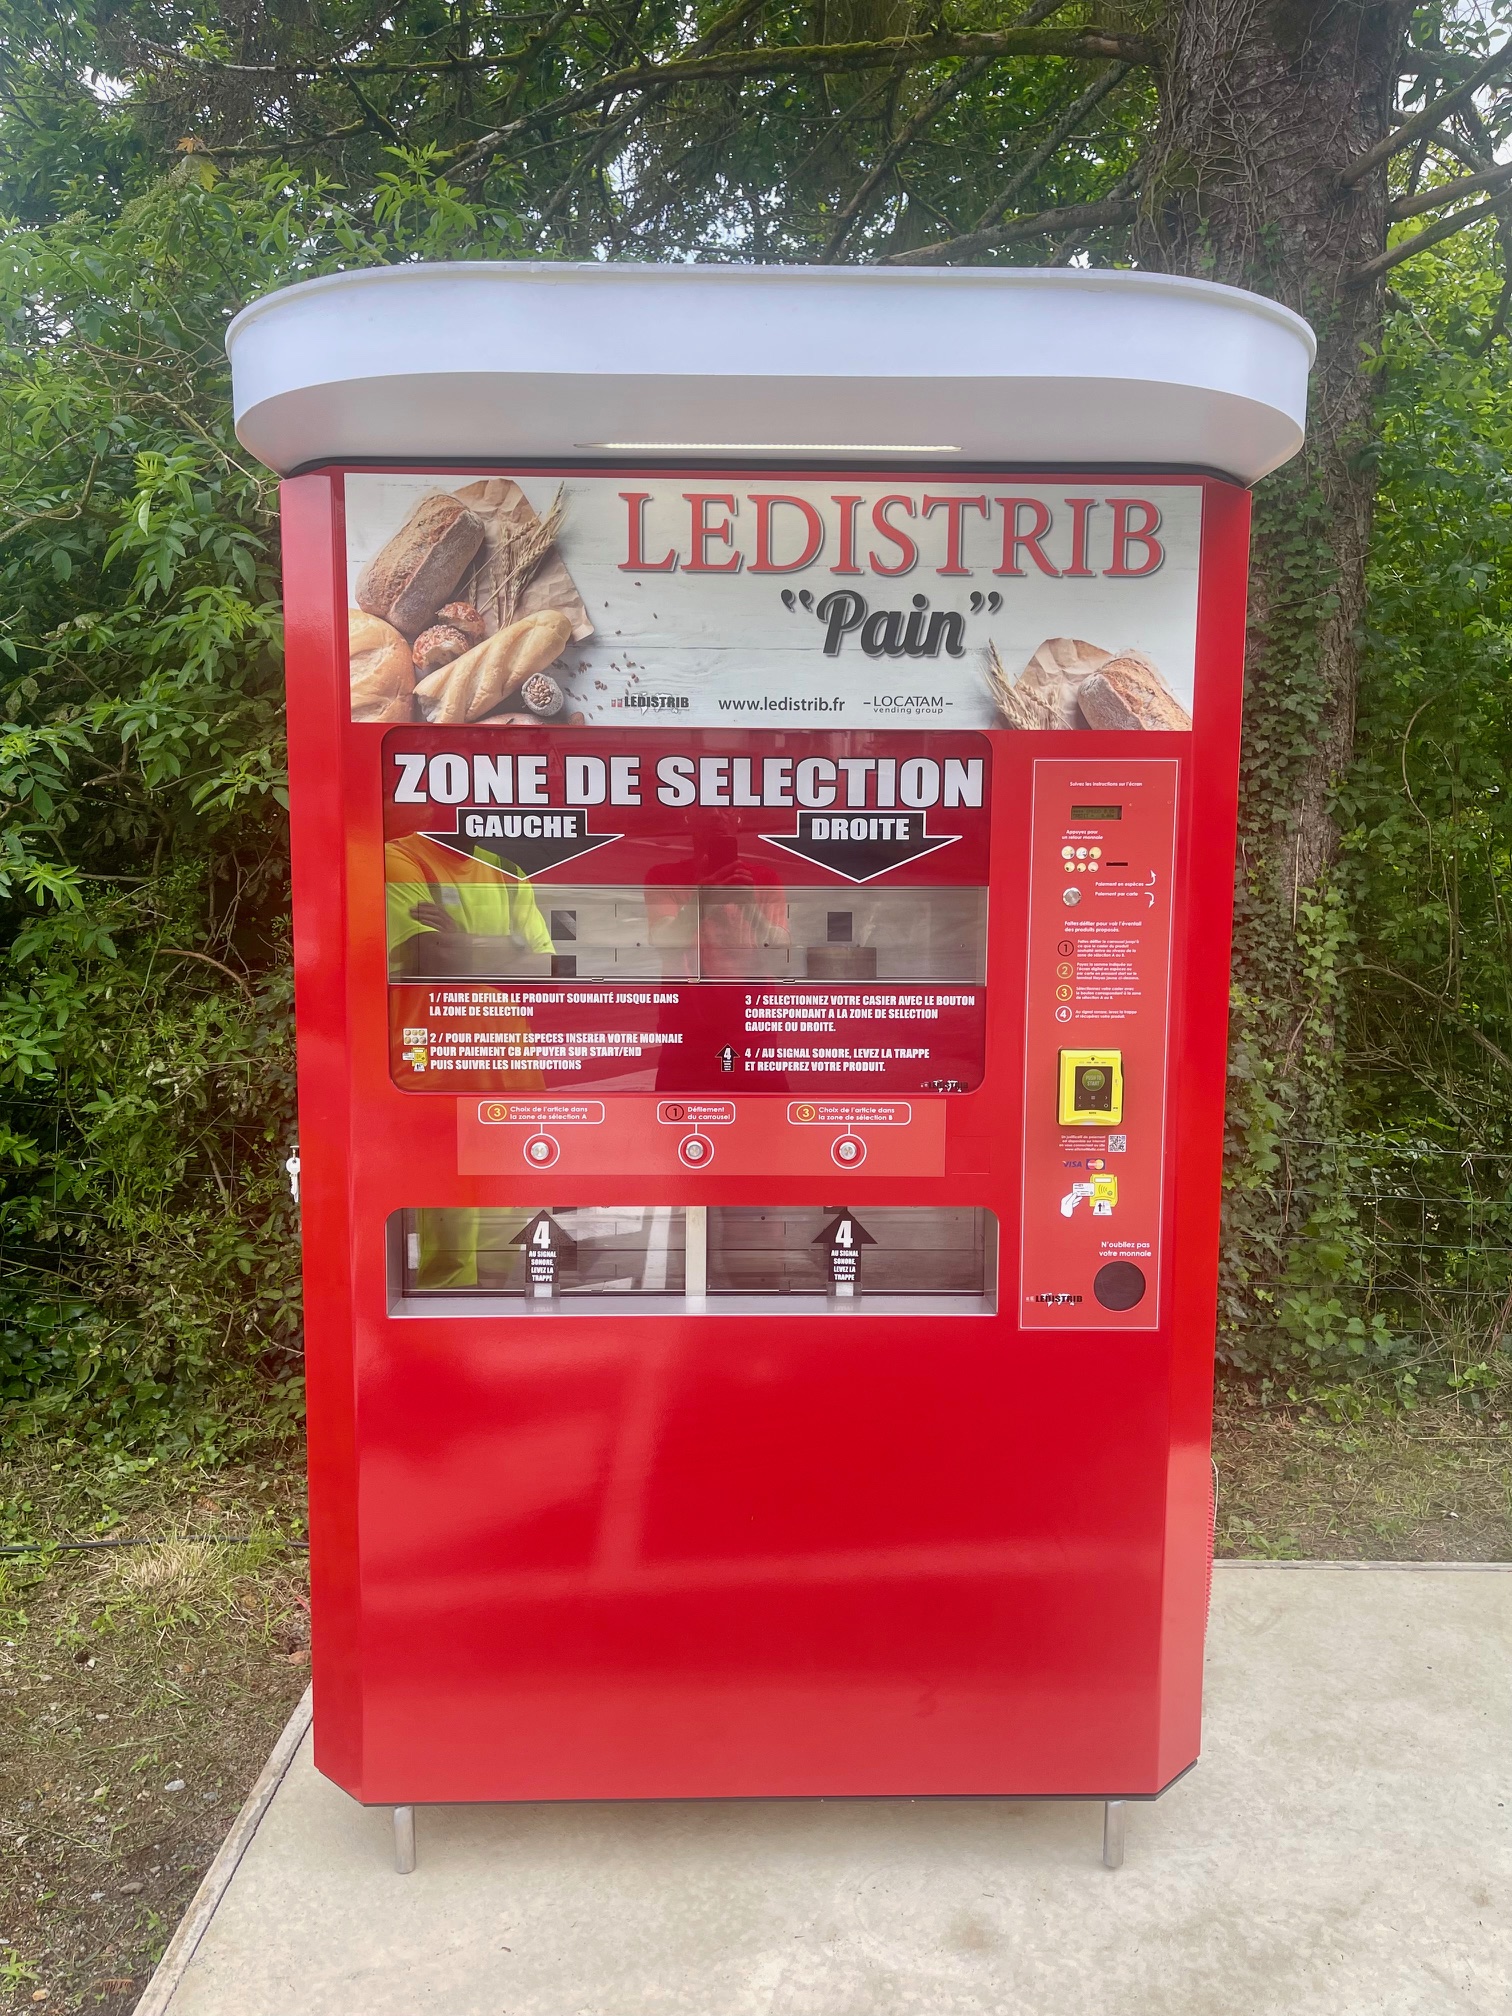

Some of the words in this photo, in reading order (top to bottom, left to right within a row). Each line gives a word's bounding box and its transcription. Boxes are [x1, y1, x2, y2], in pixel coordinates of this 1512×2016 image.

[617, 492, 1165, 578] LEDISTRIB
[624, 696, 690, 708] LEDISTRIB
[718, 696, 845, 712] www.ledistrib.fr
[873, 707, 911, 715] vending
[915, 707, 944, 715] group
[394, 754, 549, 804] ZONE
[566, 756, 641, 805] DE
[657, 756, 983, 808] SELECTION
[465, 814, 577, 838] GAUCHE
[811, 818, 910, 841] DROITE
[1061, 966, 1068, 975] 2
[429, 992, 434, 1003] 1
[436, 992, 441, 1003] /
[443, 992, 470, 1003] FAIRE
[471, 992, 509, 1003] DEFILER
[510, 993, 521, 1003] LE
[522, 993, 565, 1003] PRODUIT
[566, 991, 614, 1003] SOUHAITÉ
[615, 993, 652, 1005] JUSQUE
[653, 993, 679, 1004] DANS
[1061, 989, 1068, 997] 3
[745, 995, 752, 1005] 3
[755, 995, 761, 1005] /
[762, 995, 829, 1005] SELECTIONNEZ
[830, 995, 861, 1006] VOTRE
[862, 995, 897, 1006] CASIER
[898, 995, 923, 1006] AVEC
[924, 995, 935, 1006] LE
[936, 995, 975, 1006] BOUTON
[429, 1006, 442, 1016] LA
[442, 1006, 467, 1016] ZONE
[468, 1006, 481, 1016] DE
[482, 1006, 534, 1017] SELECTION
[745, 1008, 827, 1019] CORRESPONDANT
[828, 1008, 835, 1019] A
[836, 1008, 848, 1019] LA
[849, 1008, 873, 1019] ZONE
[874, 1008, 887, 1019] DE
[888, 1008, 938, 1019] SELECTION
[1060, 1010, 1067, 1018] 4
[745, 1021, 783, 1032] GAUCHE
[785, 1021, 798, 1032] OU
[800, 1021, 836, 1032] DROITE.
[430, 1033, 437, 1043] 2
[438, 1033, 444, 1043] /
[445, 1033, 472, 1043] POUR
[474, 1033, 522, 1043] PAIEMENT
[523, 1033, 564, 1043] ESPECES
[565, 1033, 606, 1043] INSERER
[607, 1033, 638, 1043] VOTRE
[640, 1033, 683, 1044] MONNAIE
[430, 1046, 457, 1057] POUR
[458, 1046, 506, 1057] PAIEMENT
[508, 1046, 522, 1057] CB
[523, 1046, 566, 1057] APPUYER
[568, 1046, 588, 1057] SUR
[589, 1046, 642, 1057] START/END
[723, 1047, 732, 1060] 4
[744, 1048, 752, 1058] 4
[755, 1048, 760, 1058] /
[761, 1048, 775, 1058] AU
[776, 1048, 811, 1058] SIGNAL
[812, 1048, 852, 1059] SONORE,
[853, 1048, 880, 1058] LEVEZ
[881, 1048, 893, 1059] LA
[894, 1048, 930, 1059] TRAPPE
[430, 1059, 454, 1070] PUIS
[455, 1059, 491, 1070] SUIVRE
[492, 1059, 509, 1070] LES
[510, 1059, 582, 1070] INSTRUCTIONS
[745, 1061, 756, 1071] ET
[757, 1061, 810, 1071] RECUPEREZ
[811, 1061, 841, 1072] VOTRE
[843, 1061, 886, 1072] PRODUIT.
[493, 1107, 501, 1117] 3
[673, 1108, 678, 1117] 1
[802, 1108, 810, 1118] 3
[1061, 1160, 1082, 1168] VISA
[532, 1220, 551, 1249] 4
[835, 1220, 853, 1248] 4
